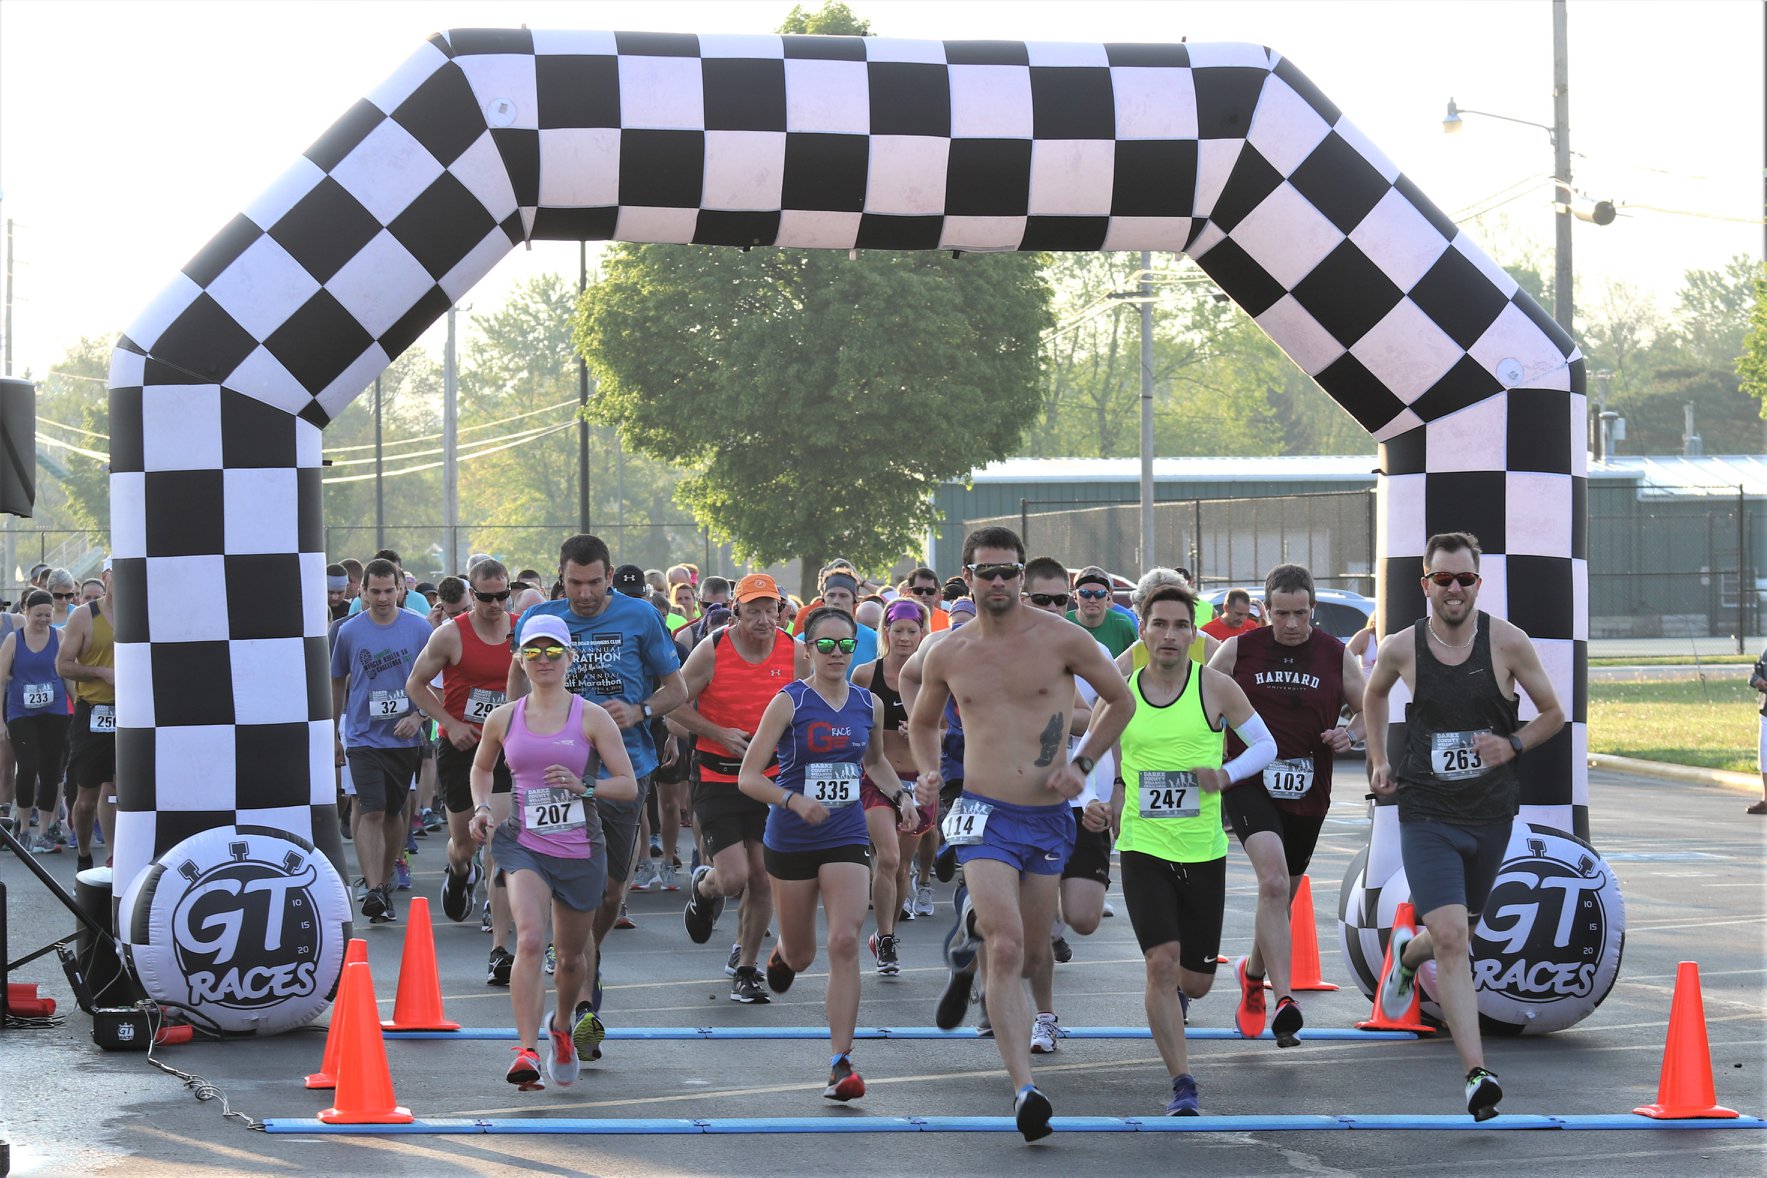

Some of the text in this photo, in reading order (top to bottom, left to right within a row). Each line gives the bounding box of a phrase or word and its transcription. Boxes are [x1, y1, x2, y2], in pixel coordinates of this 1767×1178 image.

[572, 652, 621, 663] RATHON
[578, 678, 622, 687] Marathon
[1254, 671, 1320, 689] HARVARD
[29, 692, 48, 704] 233
[381, 701, 398, 714] 32
[473, 702, 501, 718] 29
[1443, 749, 1482, 772] 263
[815, 780, 850, 801] 335
[1272, 771, 1305, 792] 103
[1149, 789, 1187, 810] 247
[535, 803, 571, 827] 207
[946, 815, 975, 837] 114
[292, 899, 302, 907] 10
[174, 864, 317, 965] GT
[1474, 871, 1606, 954] GT
[301, 921, 310, 929] 15
[1589, 923, 1598, 931] 15
[297, 946, 309, 954] 20
[1583, 947, 1593, 955] 20
[187, 962, 316, 1006] RACES
[1473, 959, 1596, 997] RACES
